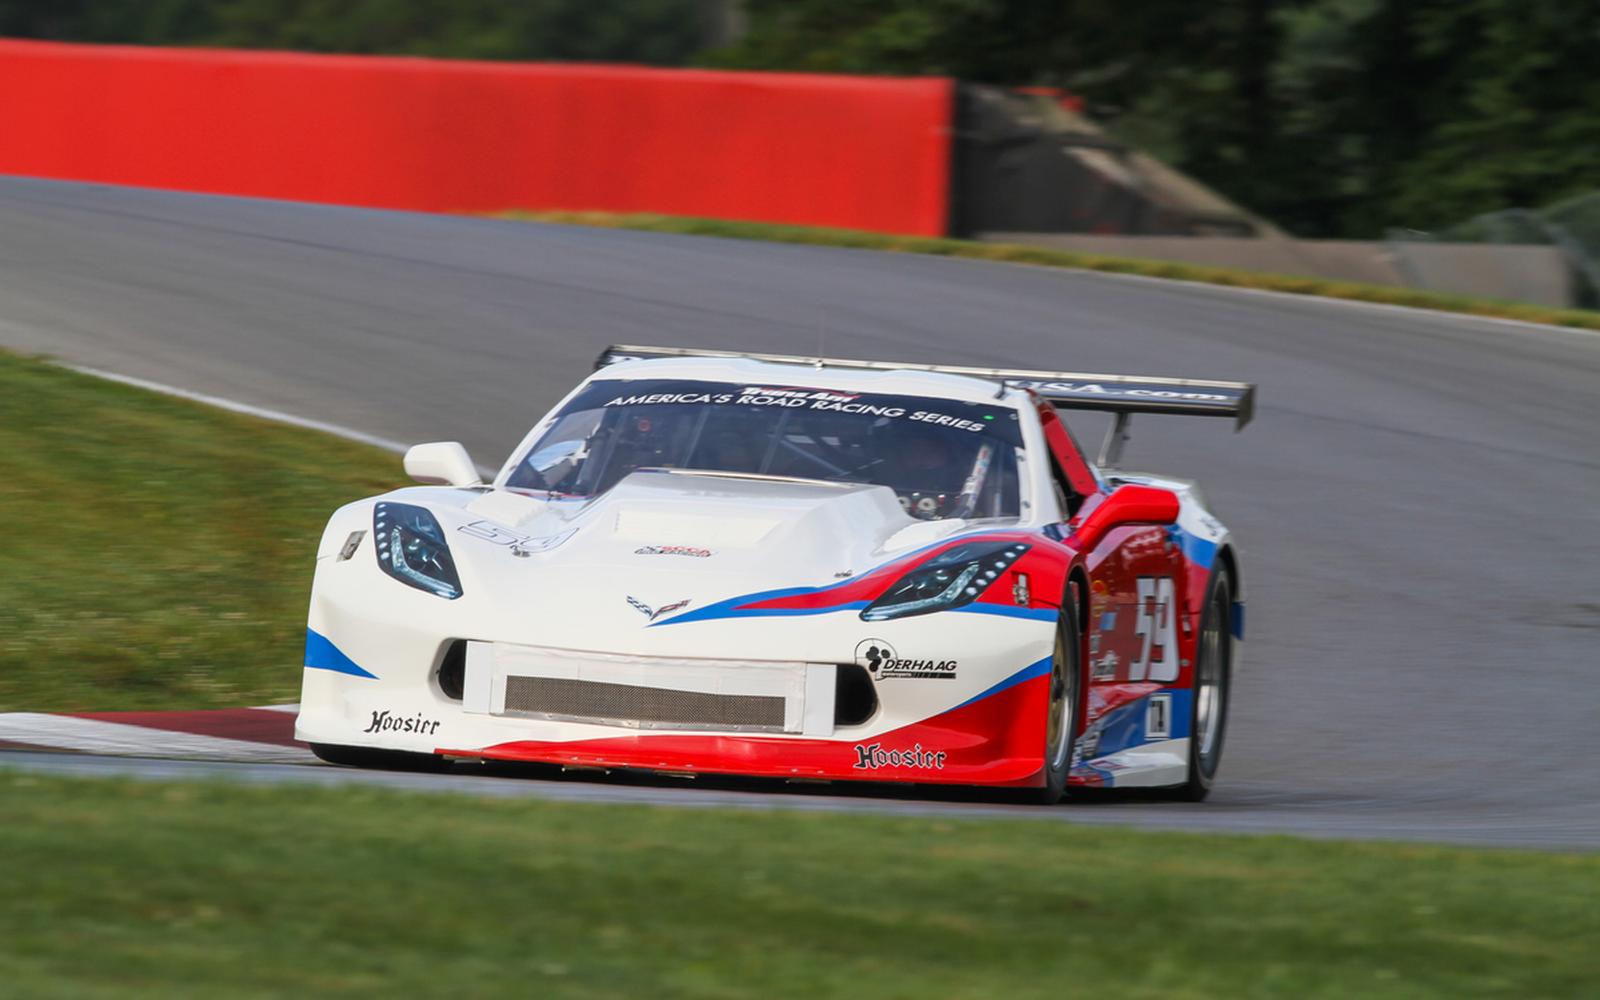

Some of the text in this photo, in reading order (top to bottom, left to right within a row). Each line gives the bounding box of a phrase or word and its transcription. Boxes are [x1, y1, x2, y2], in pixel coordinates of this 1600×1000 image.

[604, 393, 985, 433] AMERICA'S ROAD RACING SERIES
[1128, 576, 1180, 683] 59
[883, 659, 957, 671] DERHAAG
[363, 710, 441, 736] Hoosier
[853, 743, 947, 769] Hoosier
